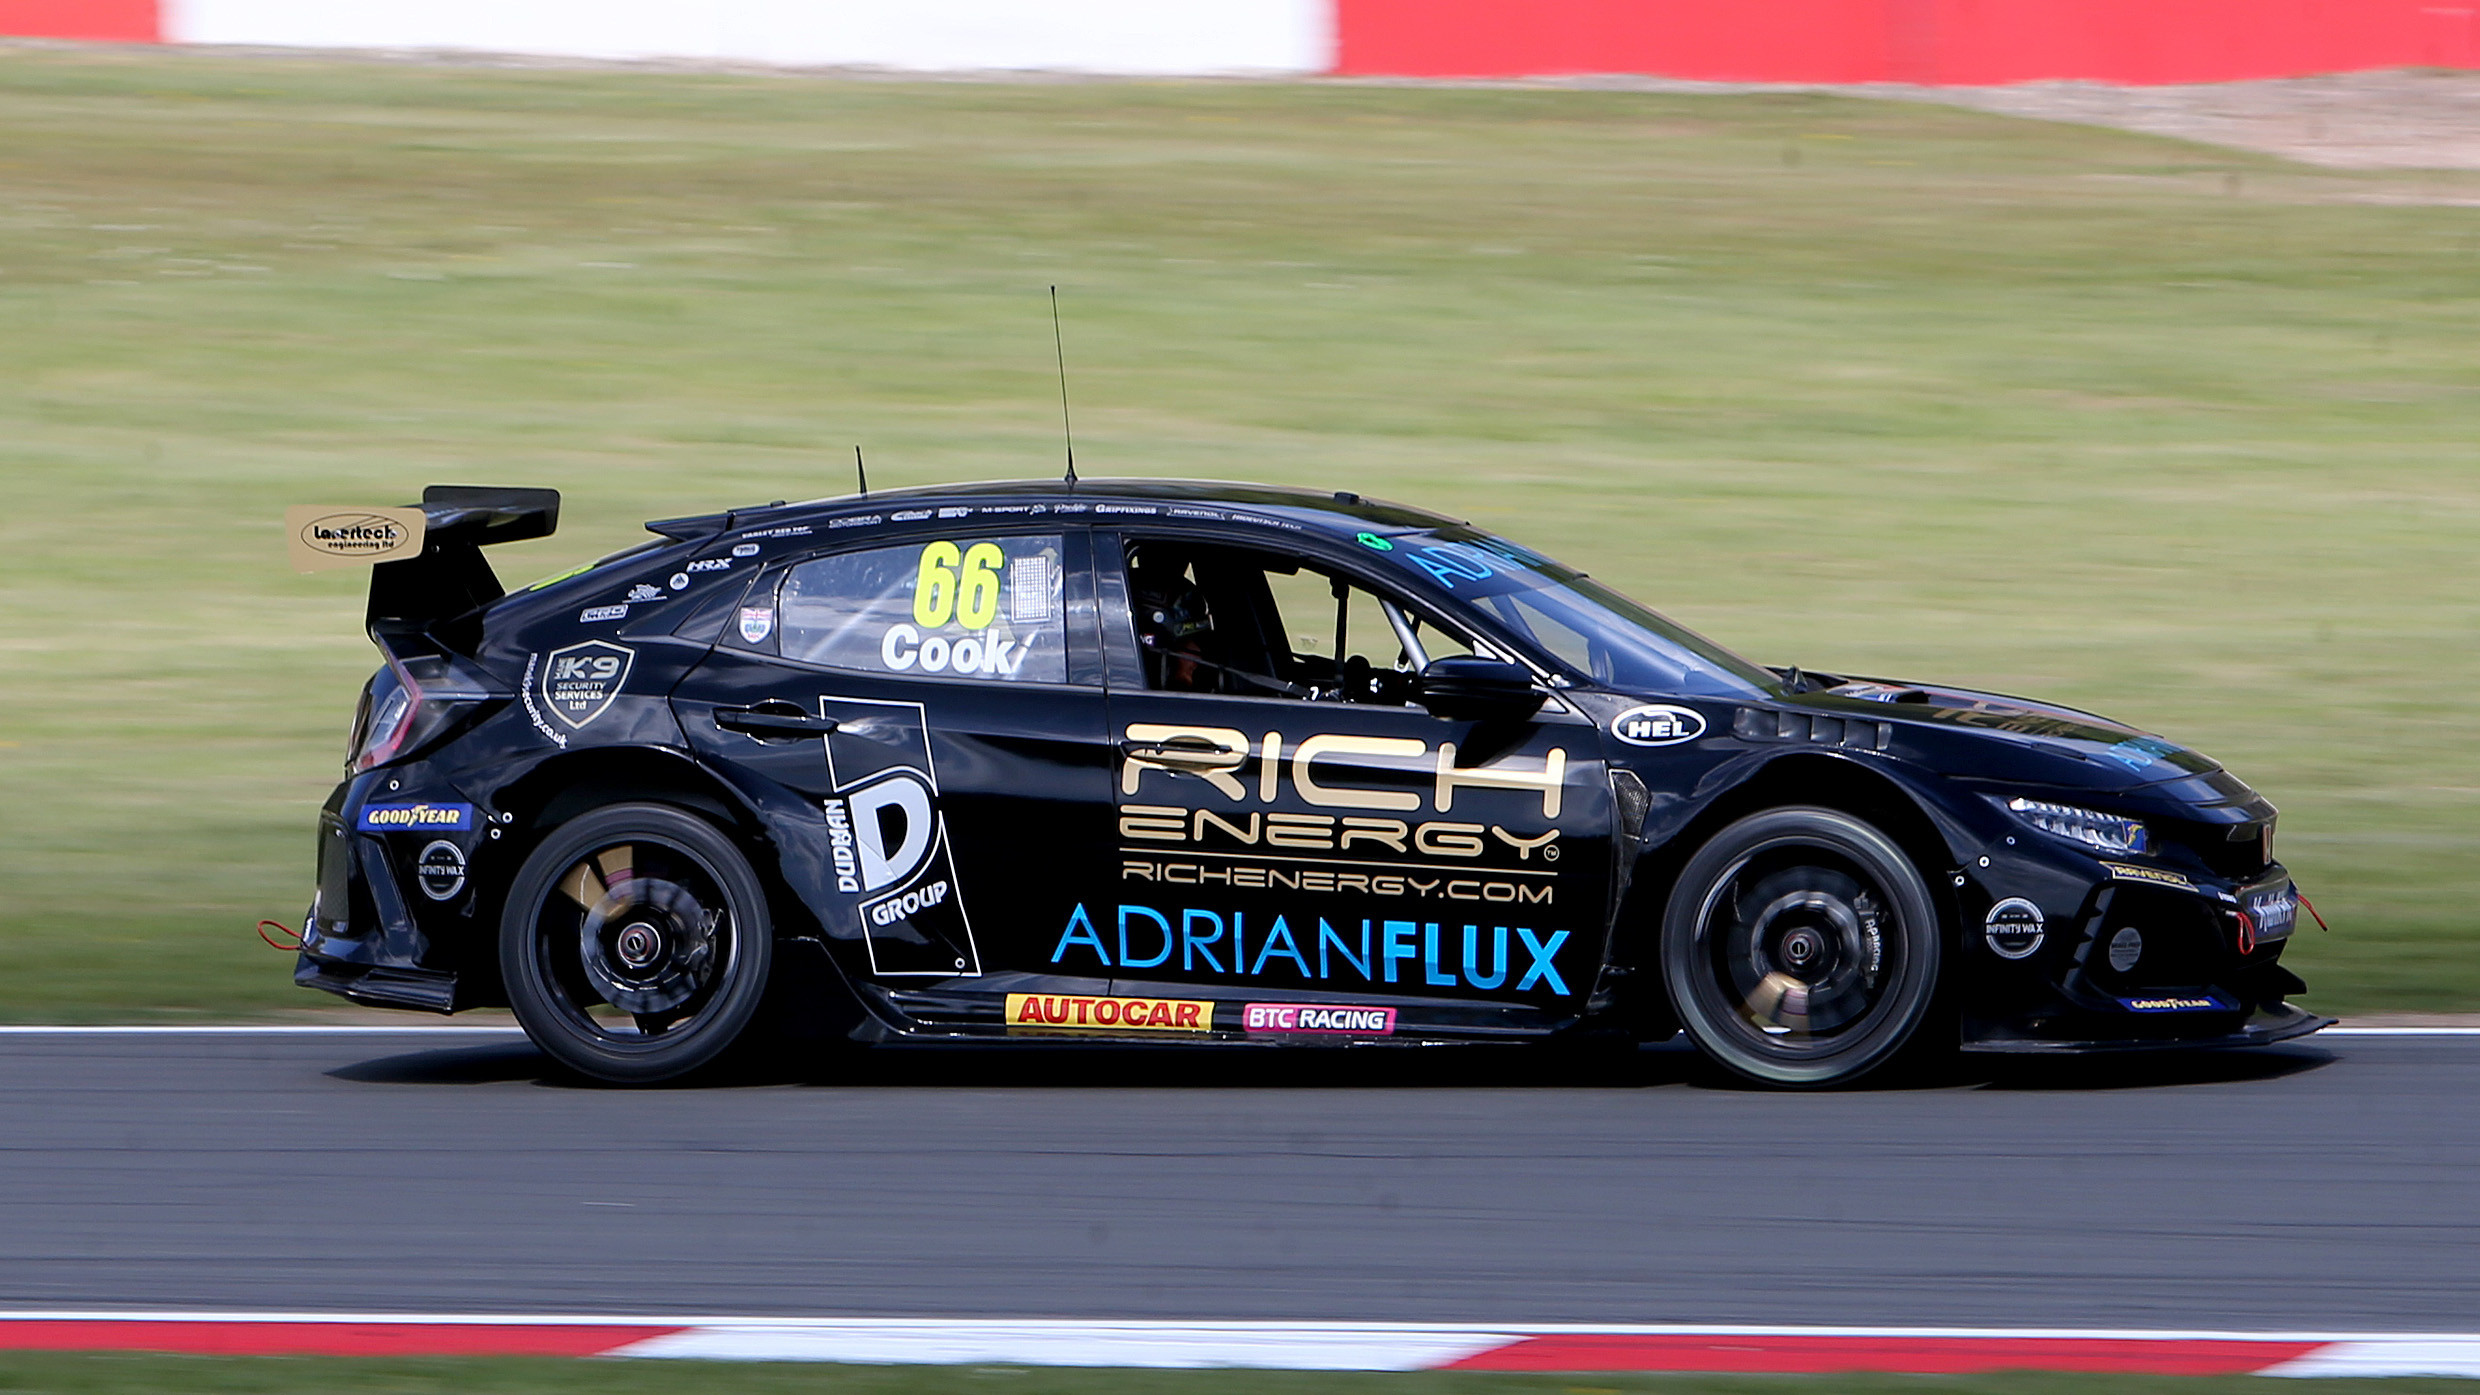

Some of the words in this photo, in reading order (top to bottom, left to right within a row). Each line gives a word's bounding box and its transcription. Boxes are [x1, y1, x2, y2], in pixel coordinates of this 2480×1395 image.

[328, 540, 380, 550] engineering
[913, 540, 1005, 630] 66
[881, 623, 1016, 674] Cook
[562, 656, 620, 680] K9
[554, 690, 605, 700] SERVICES
[556, 682, 607, 691] SECURITY
[569, 700, 587, 711] Ltd
[1628, 720, 1690, 738] HEL
[1121, 723, 1567, 820] RICH
[368, 804, 460, 828] GOODYEAR
[848, 775, 932, 892] D
[1119, 804, 1560, 860] ENERGY
[823, 799, 861, 893] DUDMAN
[446, 866, 465, 876] WAX
[1122, 861, 1553, 905] RICHENERGY.COM
[871, 880, 948, 927] GROUP
[1986, 923, 2021, 934] INFINITY
[2022, 923, 2044, 934] WAX
[1017, 997, 1202, 1028] AUTOCAR
[2130, 998, 2212, 1011] GOODYEAR
[1249, 1007, 1294, 1028] BTC
[1299, 1008, 1386, 1030] RACING
